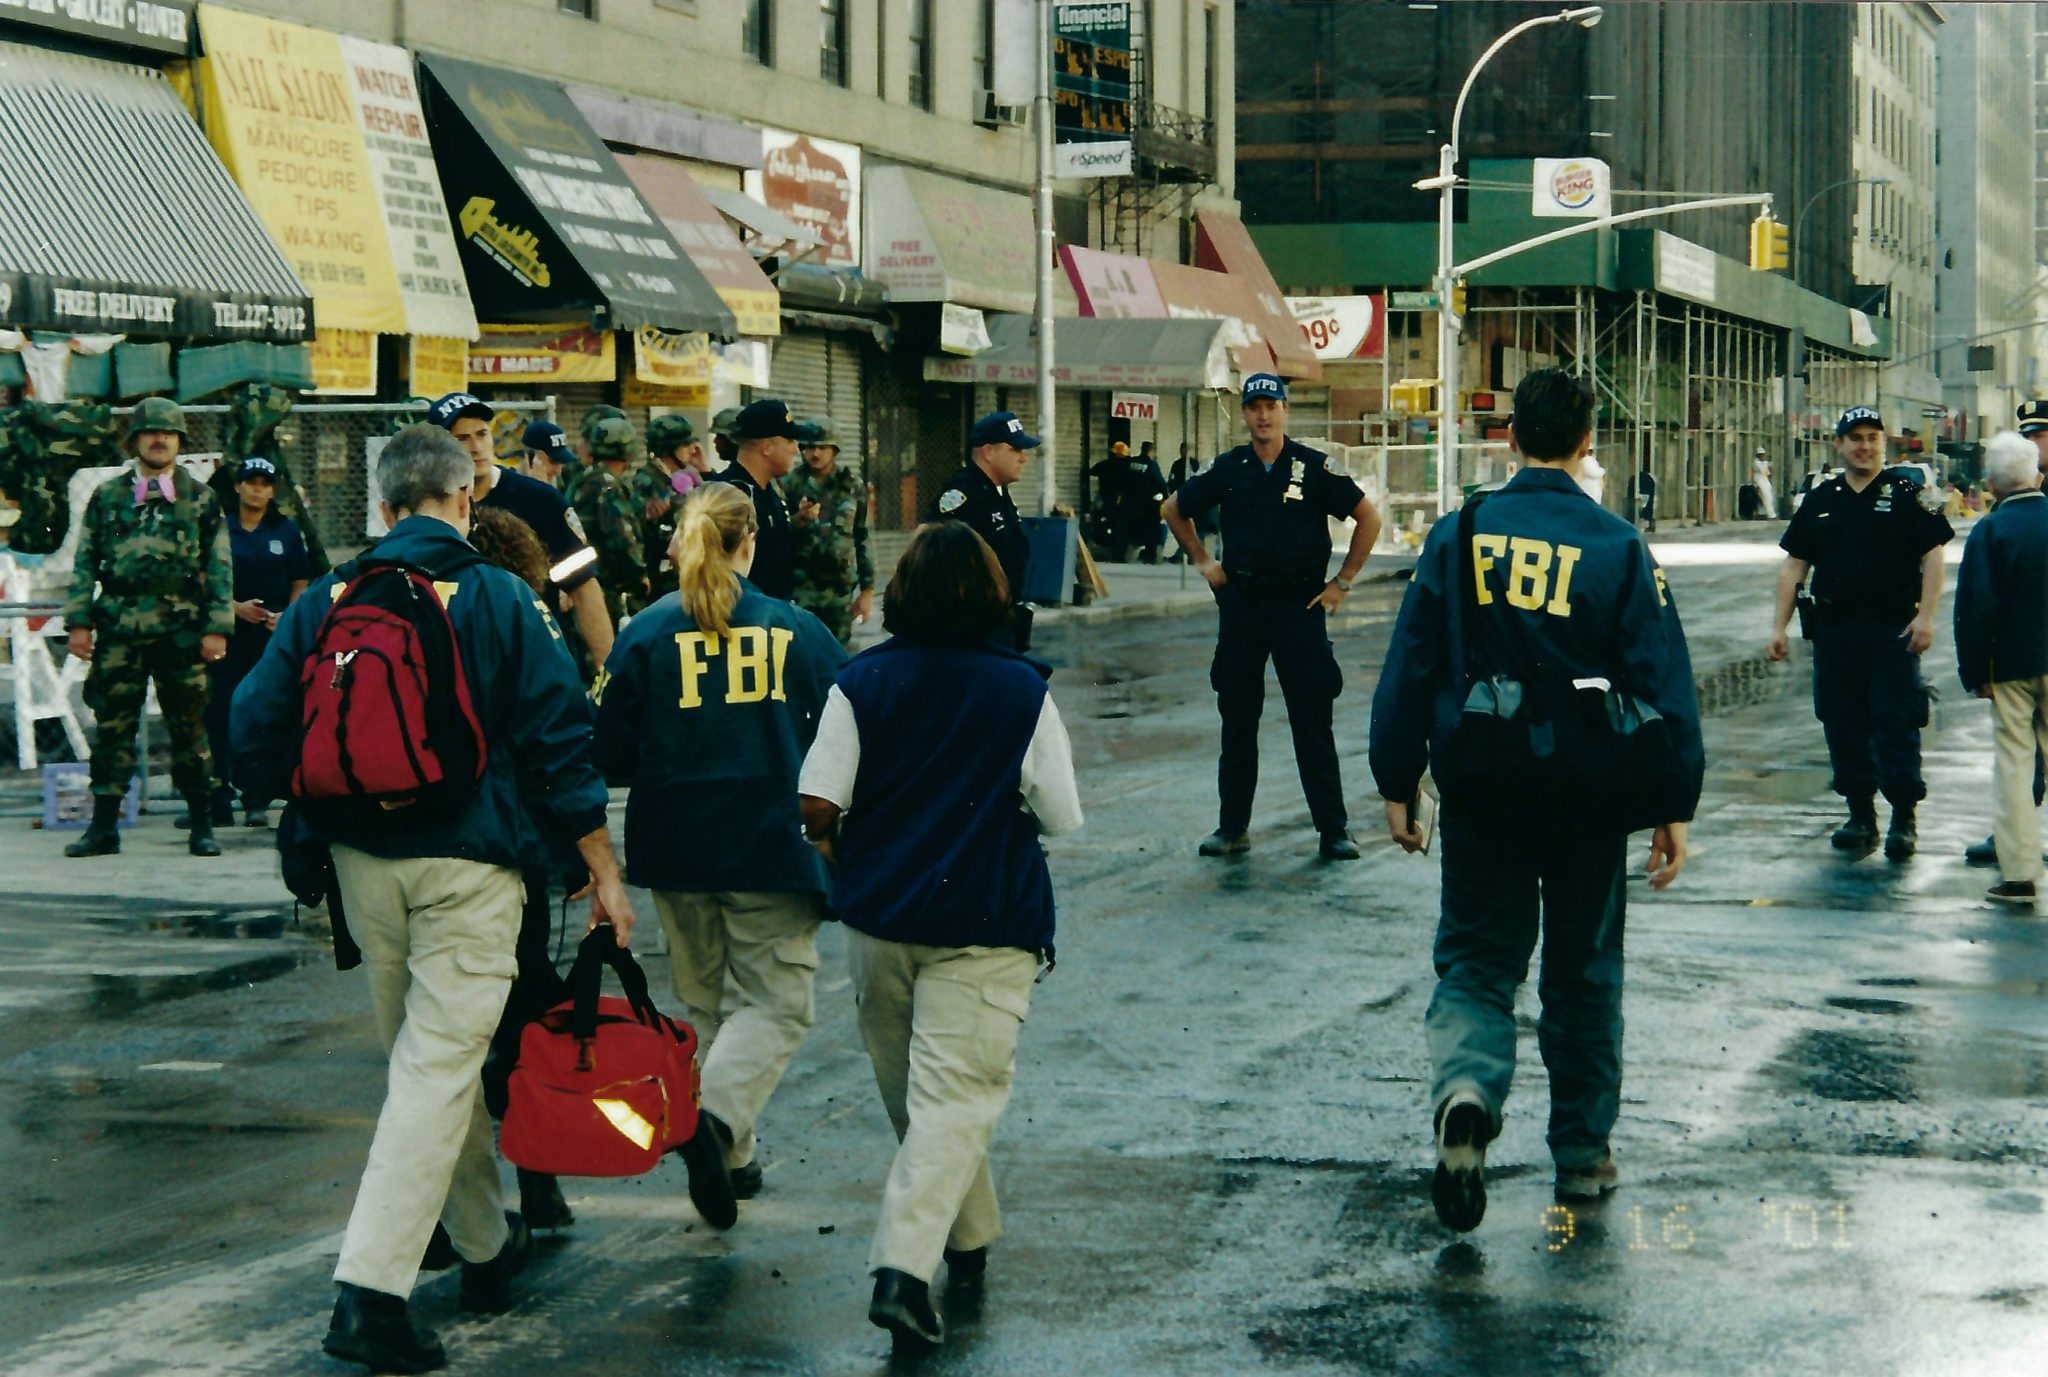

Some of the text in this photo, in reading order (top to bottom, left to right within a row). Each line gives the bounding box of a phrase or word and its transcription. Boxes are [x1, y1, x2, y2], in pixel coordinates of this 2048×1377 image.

[1059, 4, 1127, 25] financial
[215, 50, 356, 125] NAIL SALON
[353, 66, 412, 101] WATCH
[362, 103, 424, 139] REPAIR
[246, 126, 353, 163] MANICURE
[258, 159, 358, 193] PEDICURE
[1556, 178, 1594, 199] KING
[294, 193, 339, 221] TIPS
[282, 224, 366, 255] WAXING
[890, 240, 921, 253] FREE
[879, 255, 937, 268] DELIVERY
[54, 287, 176, 323] FREE DELIVERY
[500, 356, 554, 373] MADE
[1246, 378, 1278, 393] NYPD
[1114, 401, 1154, 419] ATM
[1845, 406, 1880, 423] NYPD
[1472, 533, 1582, 618] FBI
[674, 625, 794, 709] FBI
